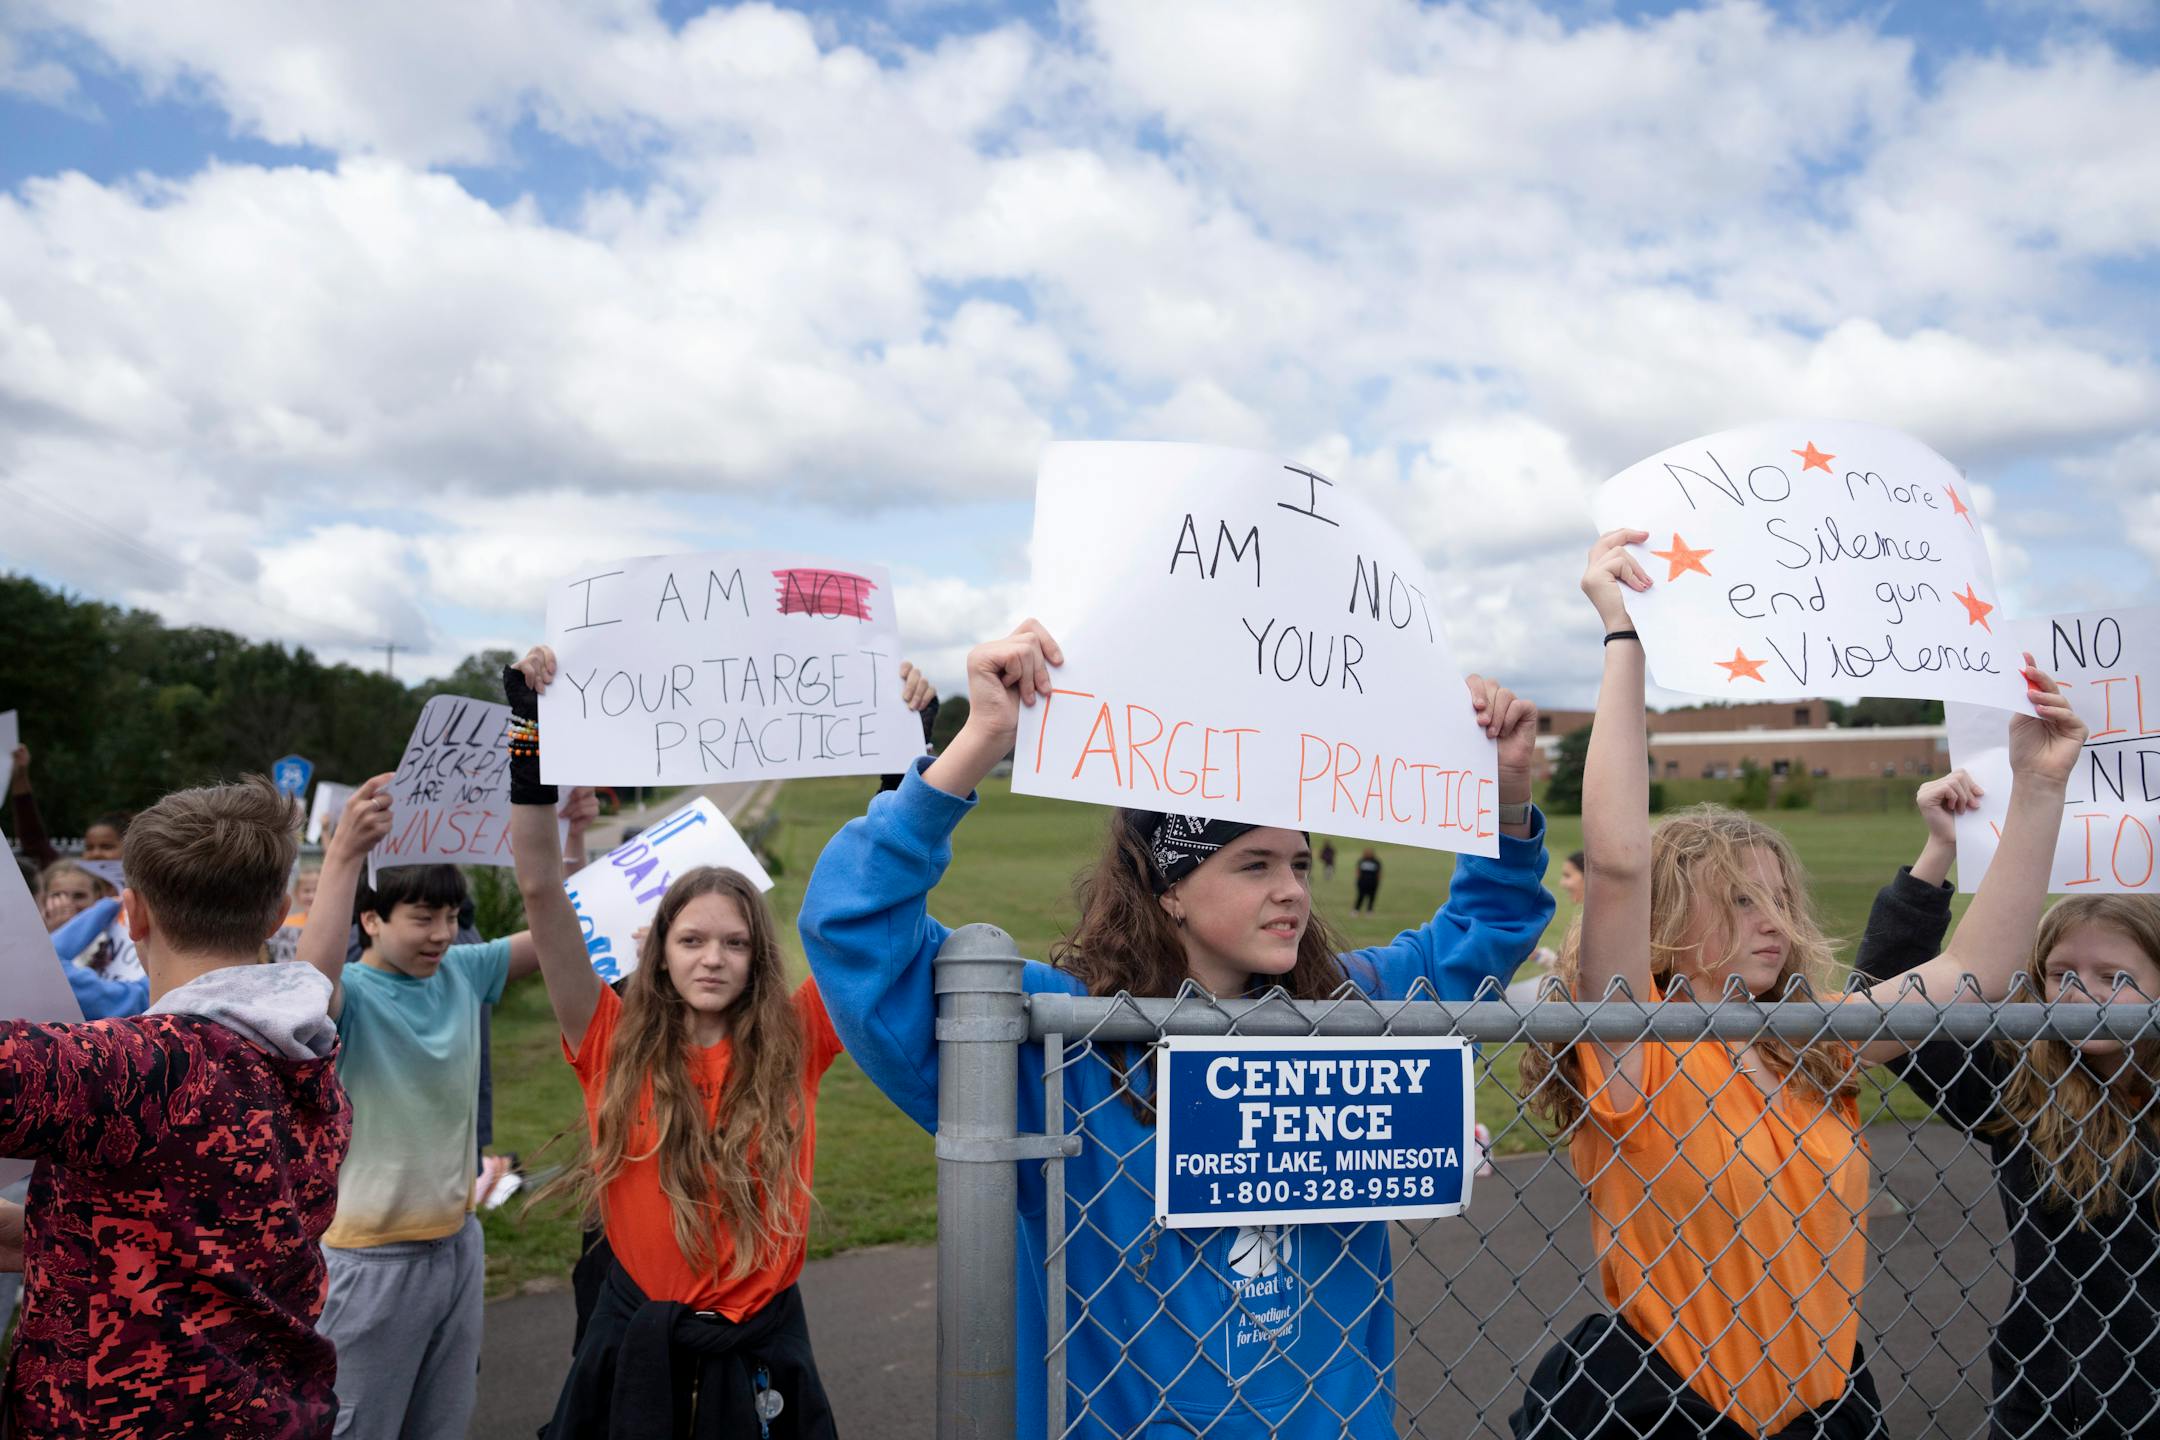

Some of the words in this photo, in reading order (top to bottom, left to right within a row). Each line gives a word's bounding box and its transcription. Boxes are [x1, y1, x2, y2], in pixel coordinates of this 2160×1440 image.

[1277, 465, 1340, 527] I
[1664, 451, 1790, 510] No
[565, 571, 624, 632] I
[657, 569, 749, 622] AM
[1170, 513, 1260, 587] AM
[1349, 554, 1433, 643] NOT
[1728, 576, 1825, 618] end
[1876, 582, 1940, 624] gun
[1242, 617, 1363, 694] YOUR
[1766, 631, 2000, 686] Violence
[2052, 617, 2121, 671] NO
[566, 664, 694, 719] YOUR
[703, 651, 888, 707] TARGET
[396, 747, 511, 786] BACKPA
[656, 713, 880, 776] PRACTICE
[1036, 688, 1261, 802] TARGET
[1298, 732, 1494, 838] PRACTICE
[406, 780, 444, 806] ARE
[455, 783, 498, 803] NOT
[1206, 1056, 1431, 1100] CENTURY
[1238, 1102, 1392, 1149] FENCE
[1175, 1152, 1260, 1176] FOREST
[1267, 1151, 1328, 1176] LAKE,
[1336, 1147, 1459, 1172] MINNESOTA
[1209, 1176, 1435, 1205] 1-800-328-9558
[1236, 1330, 1252, 1348] for
[1238, 1313, 1247, 1327] A
